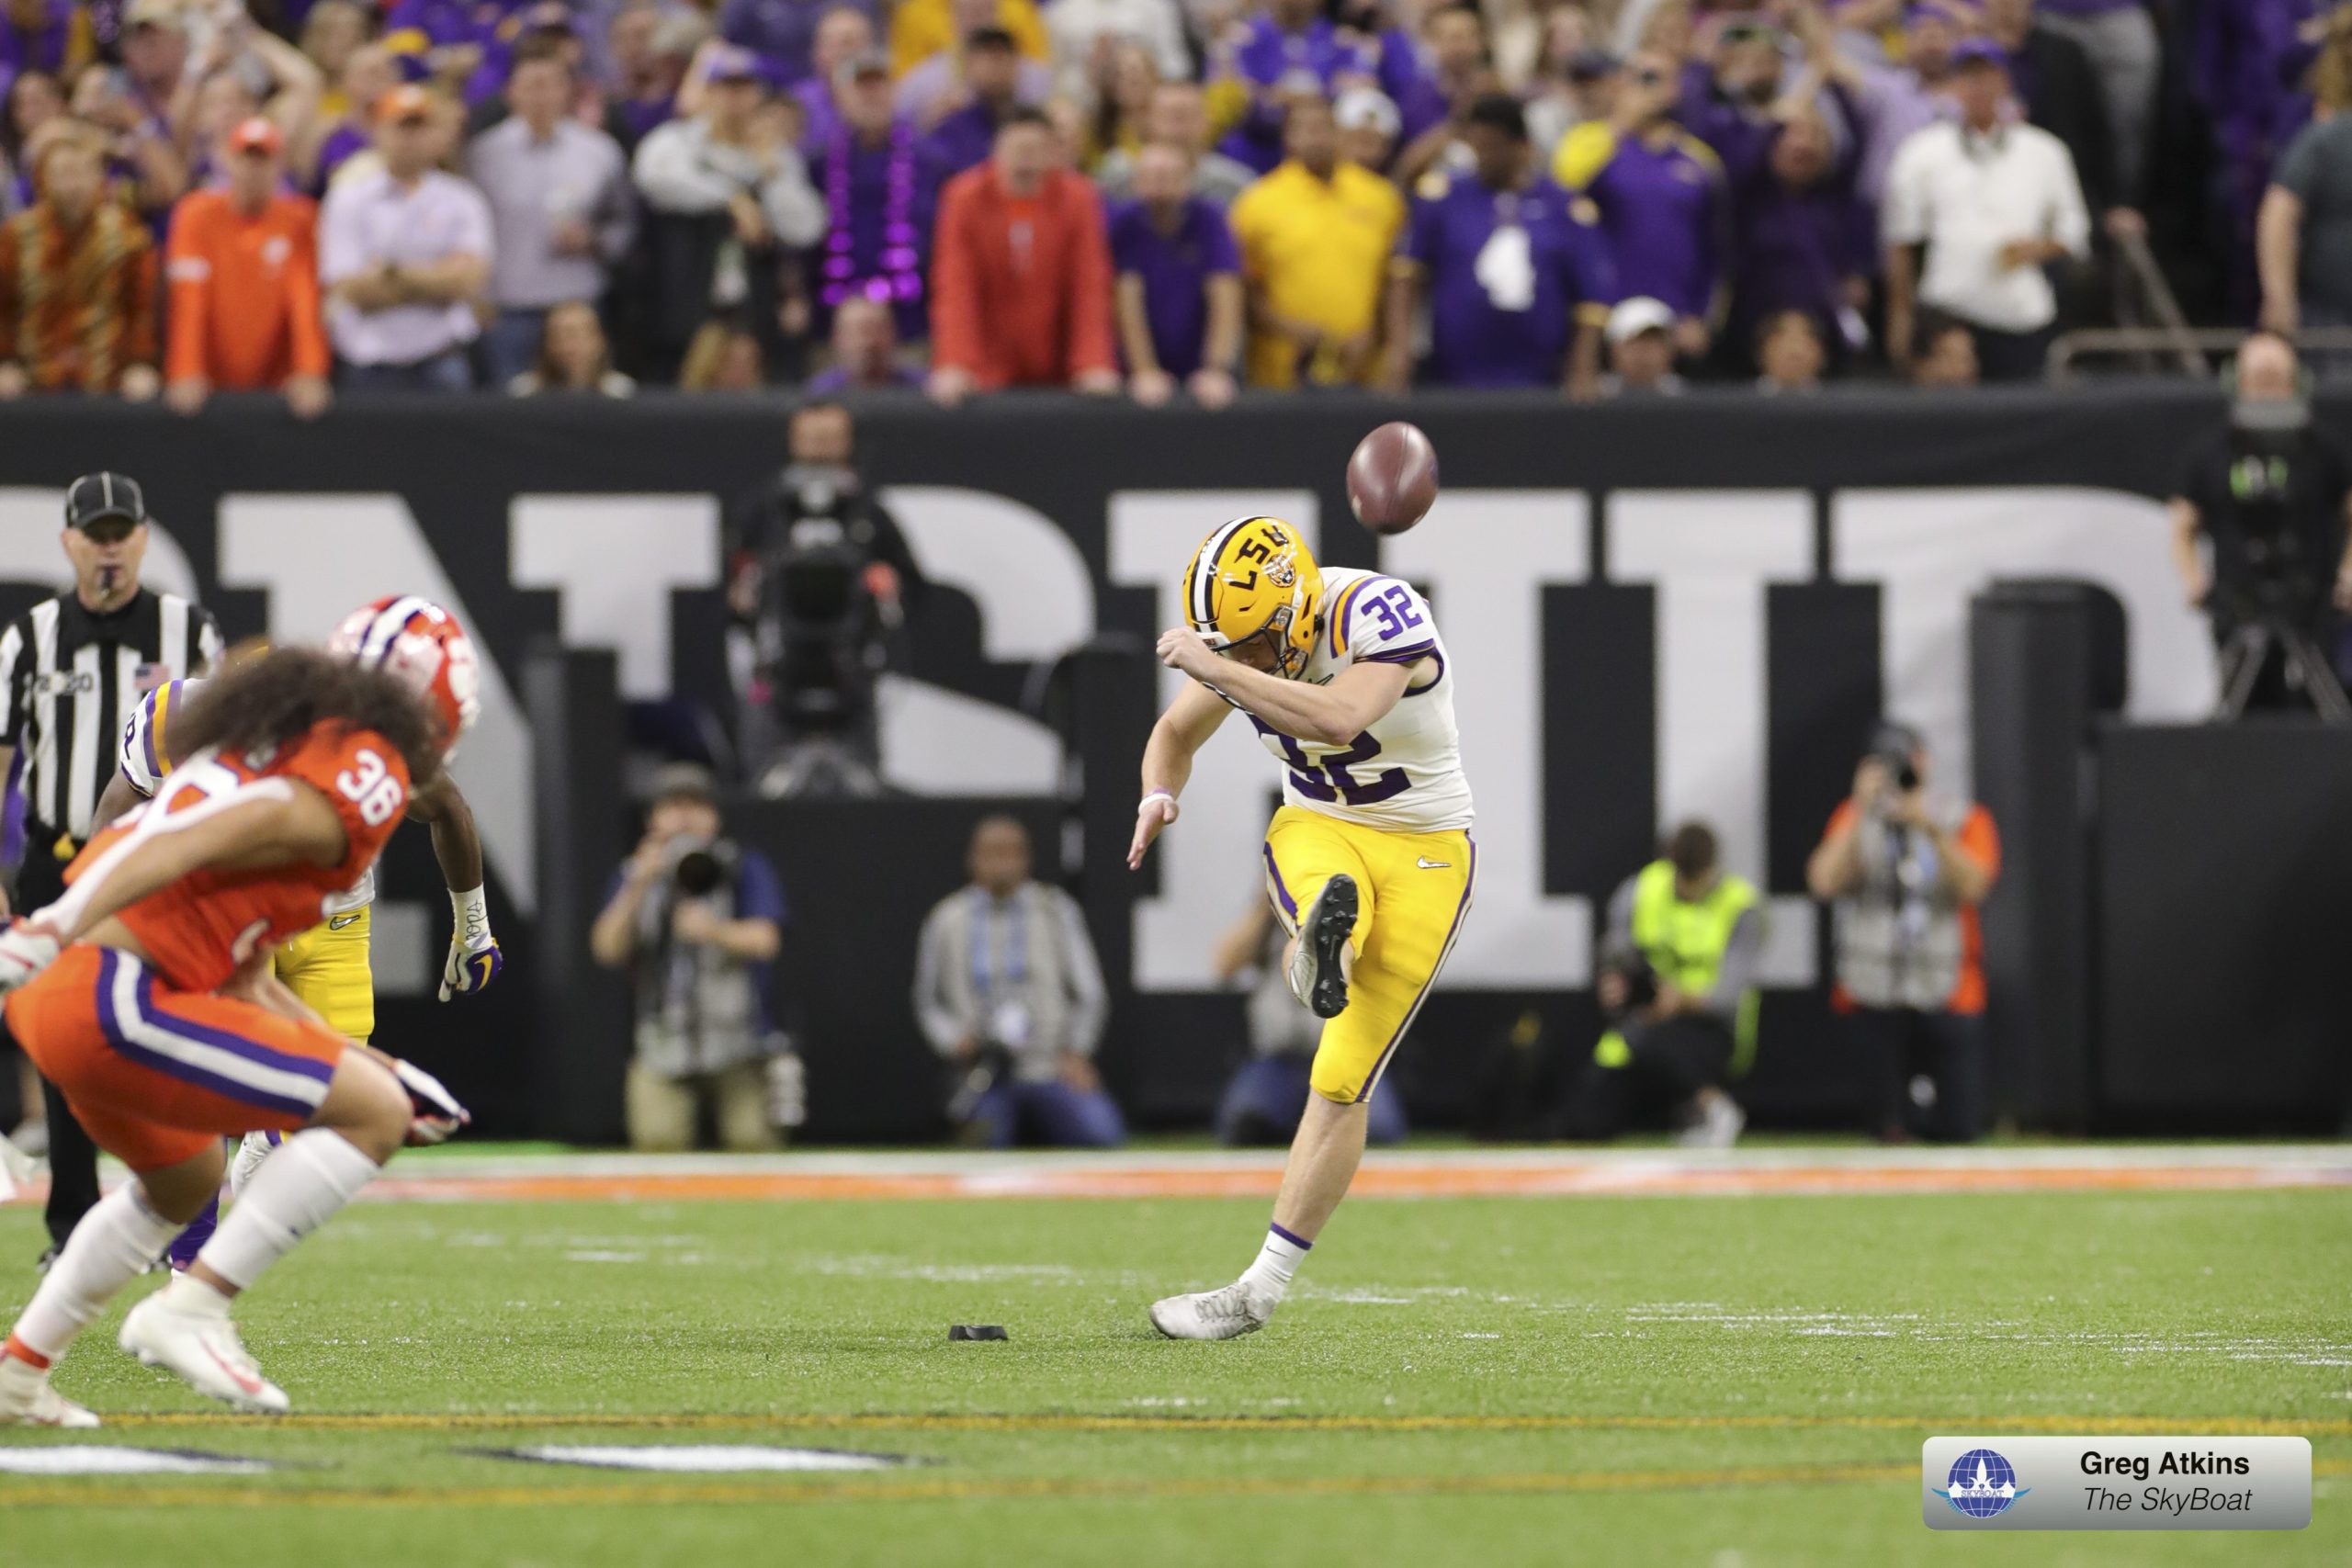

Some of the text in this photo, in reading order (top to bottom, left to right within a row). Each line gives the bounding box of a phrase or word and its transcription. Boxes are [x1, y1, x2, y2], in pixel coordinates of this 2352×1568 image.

[1229, 525, 1289, 591] LSU
[1361, 585, 1423, 641] 32
[335, 749, 402, 826] 36
[1243, 711, 1412, 806] 32
